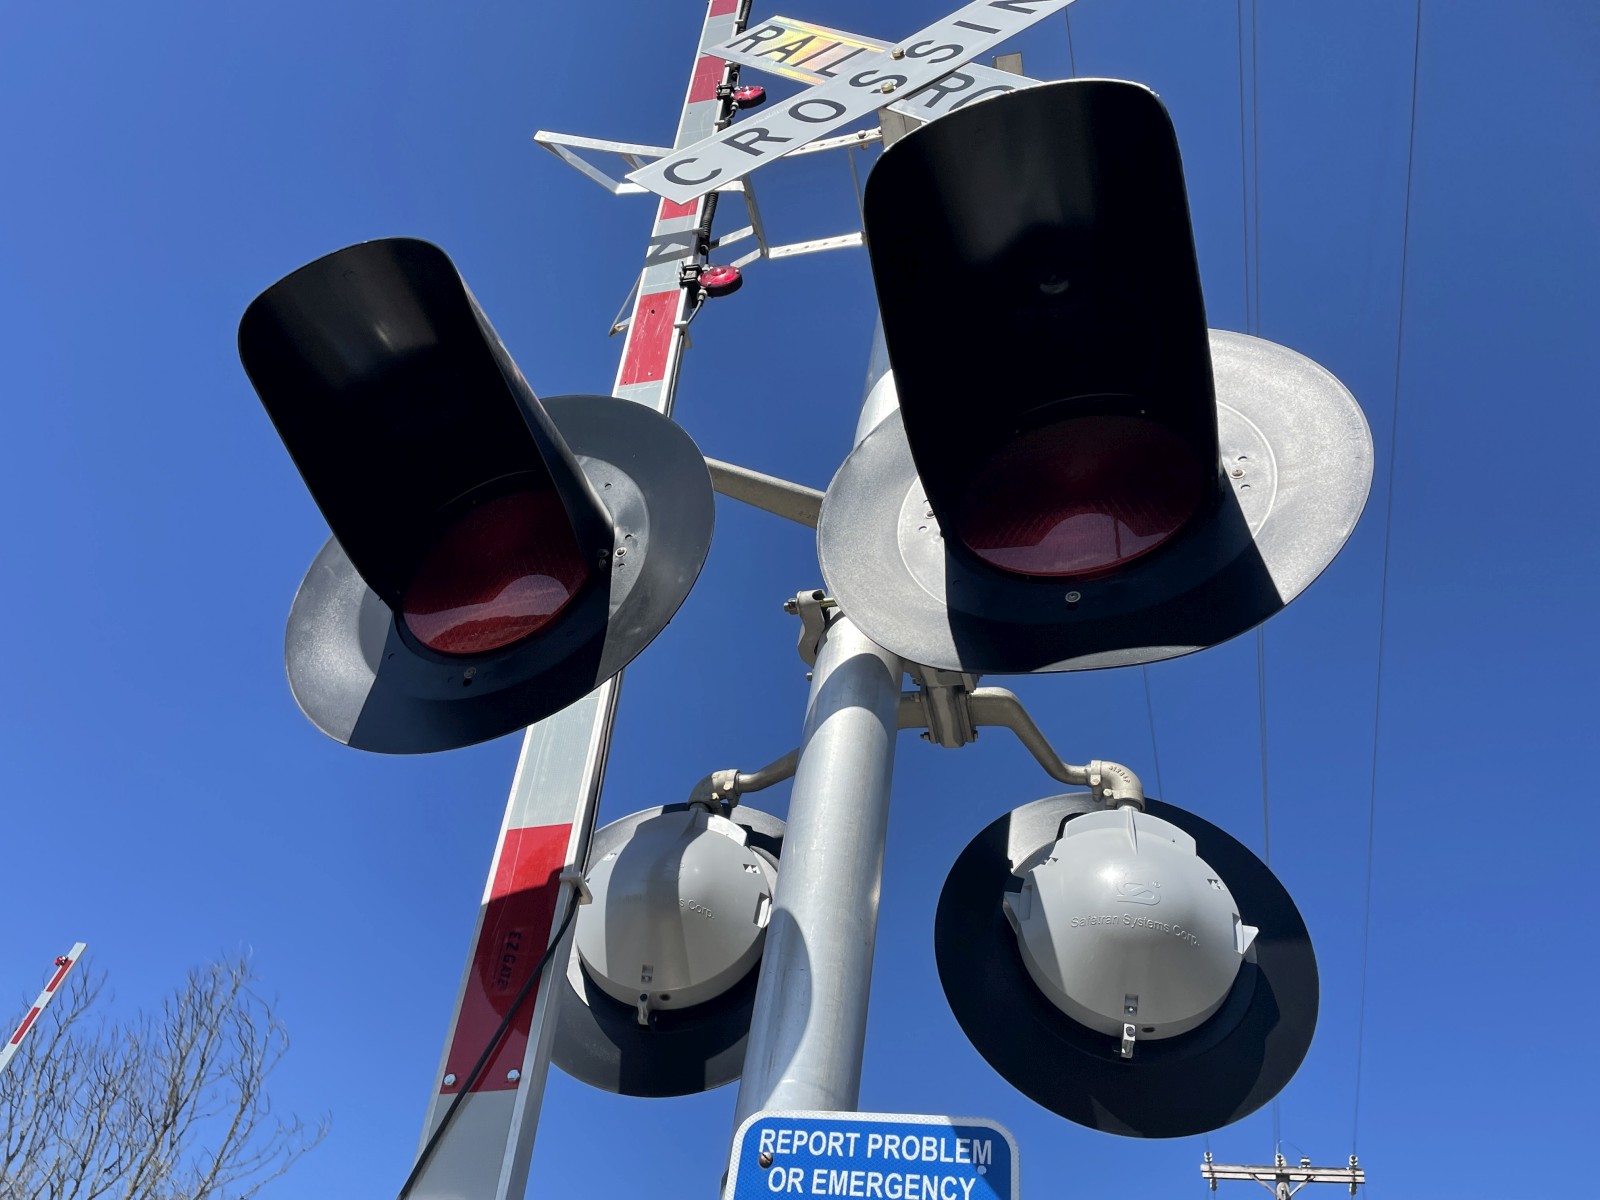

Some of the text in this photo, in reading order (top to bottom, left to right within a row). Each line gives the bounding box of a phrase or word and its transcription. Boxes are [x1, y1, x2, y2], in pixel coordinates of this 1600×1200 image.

[726, 25, 867, 77] RAIL
[687, 899, 716, 919] Corp.
[1071, 913, 1201, 948] Safetran Systems Corp.
[759, 1128, 992, 1165] REPORT PROBLEM
[767, 1166, 977, 1200] OR EMERGENCY
